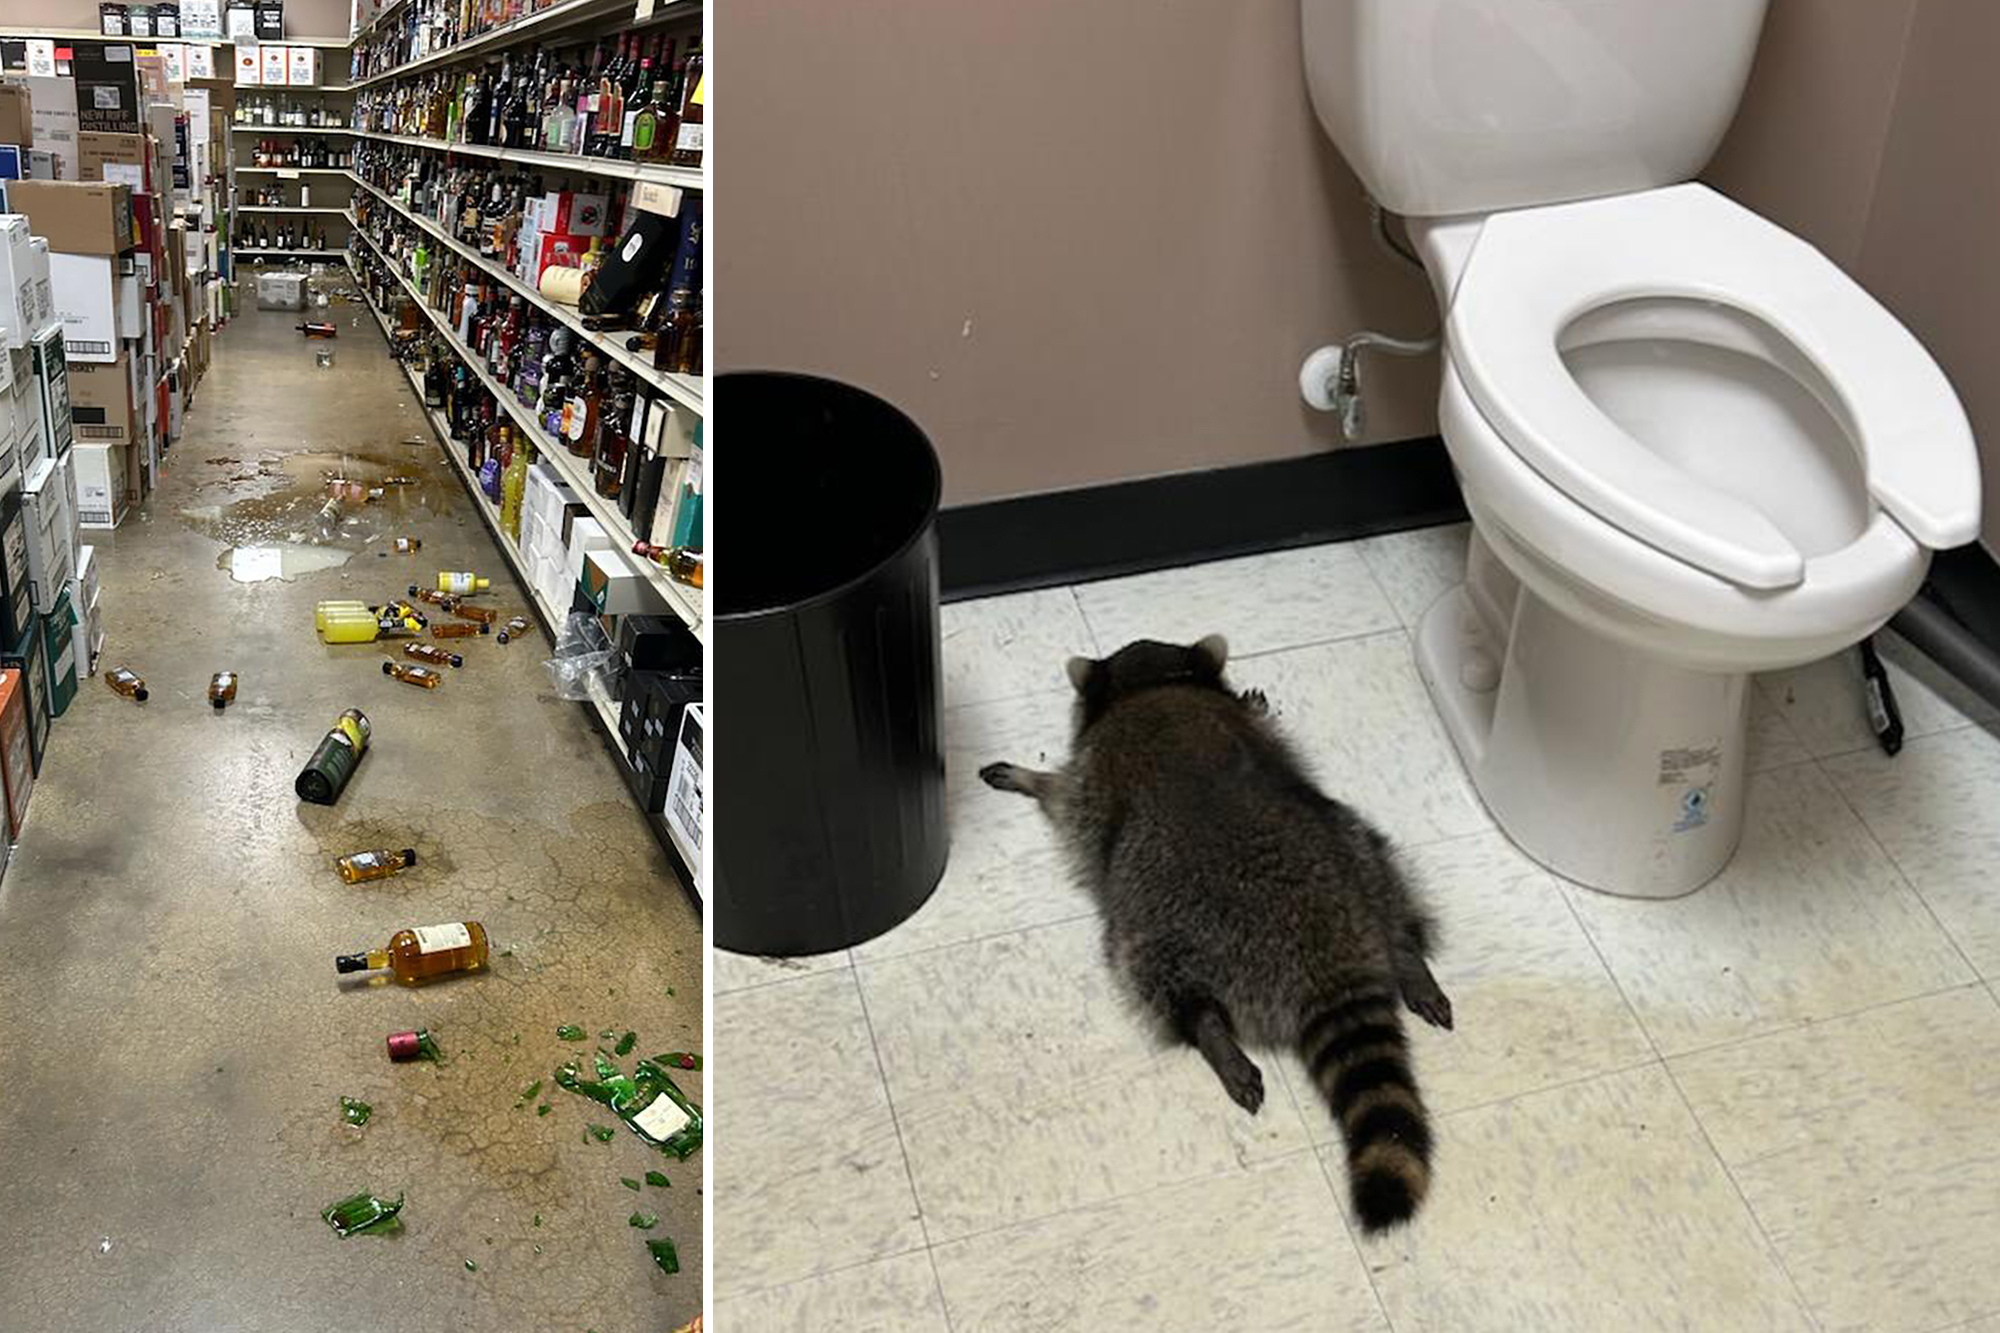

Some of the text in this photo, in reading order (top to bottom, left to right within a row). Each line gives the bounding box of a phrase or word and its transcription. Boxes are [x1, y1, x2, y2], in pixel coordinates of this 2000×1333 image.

[80, 110, 105, 120] NEW
[106, 110, 129, 120] RIFF
[81, 121, 137, 132] DISTILLING
